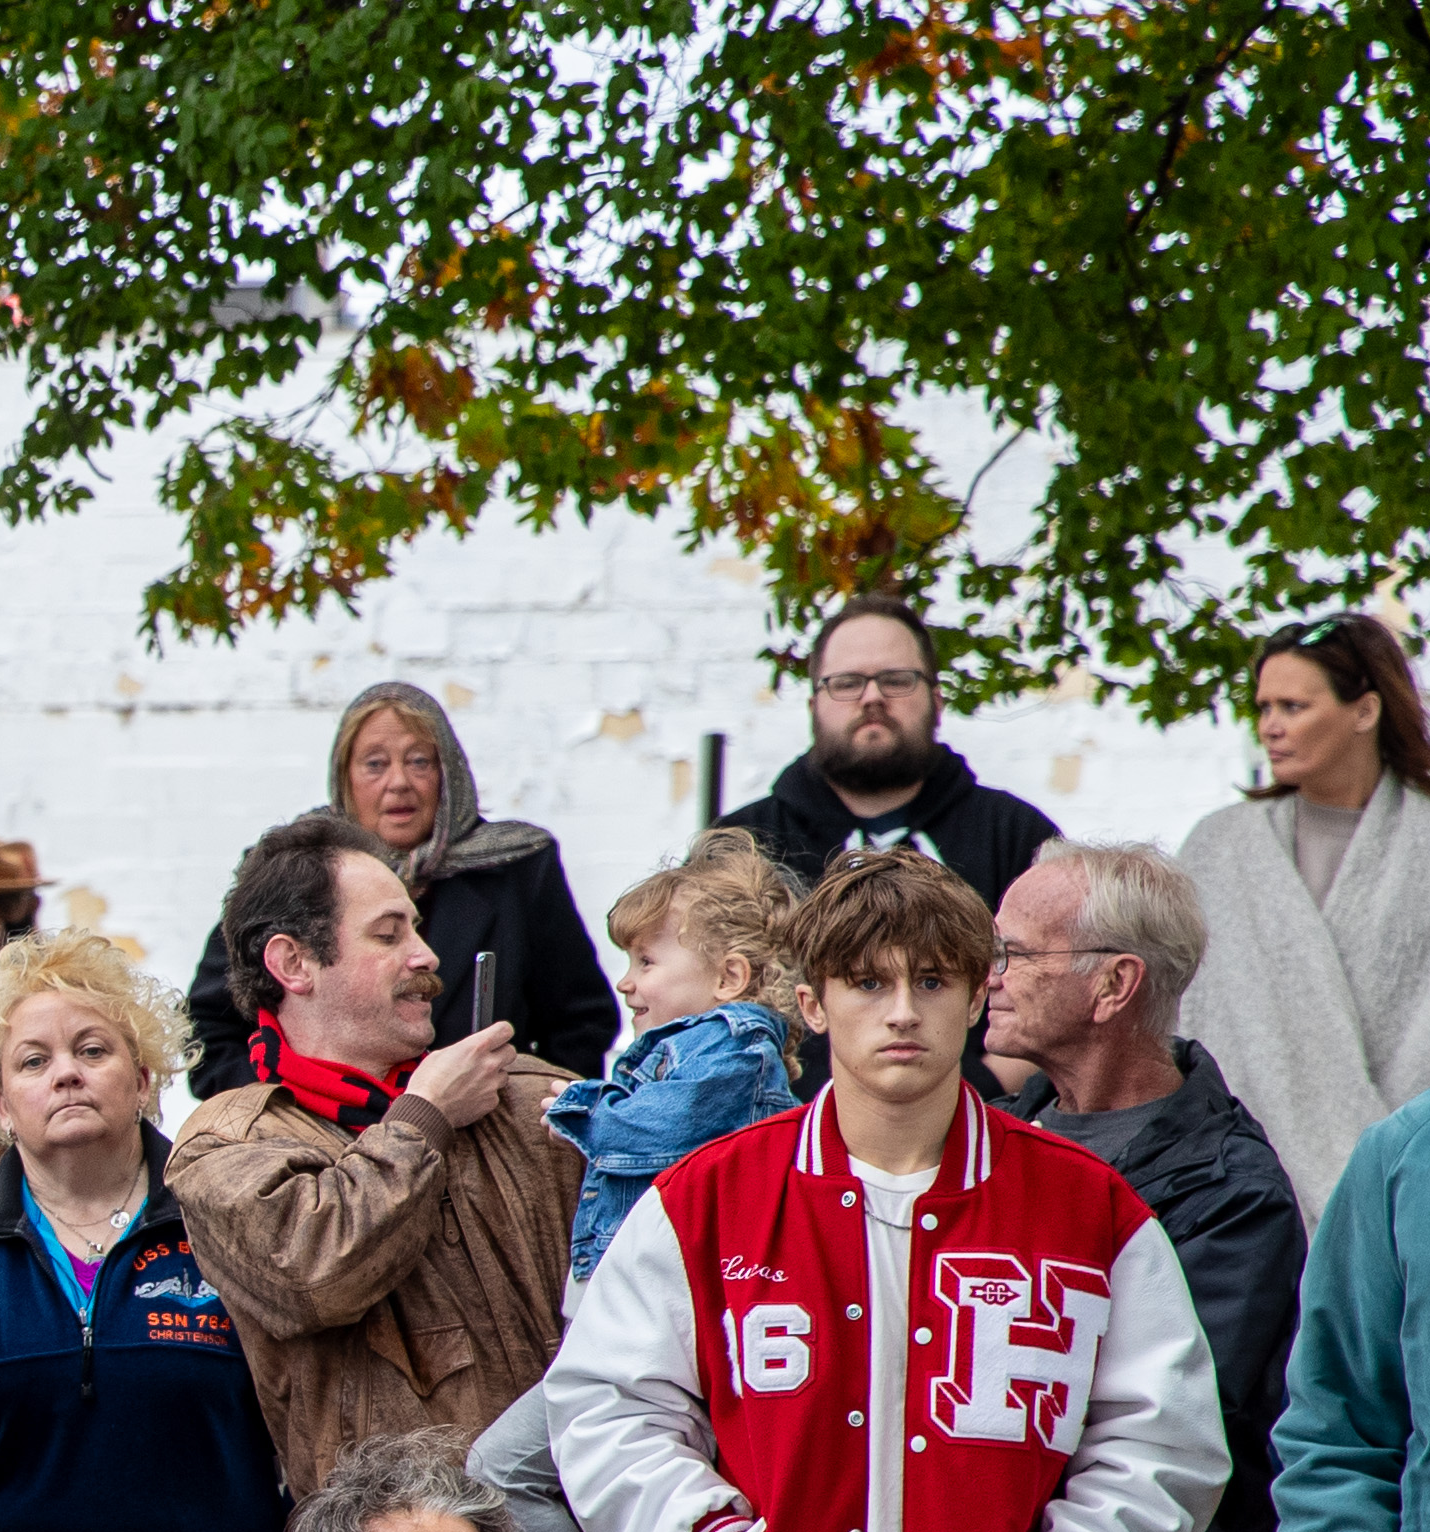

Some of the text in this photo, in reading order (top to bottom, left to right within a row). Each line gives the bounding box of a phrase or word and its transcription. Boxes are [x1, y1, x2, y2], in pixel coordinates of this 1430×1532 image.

[133, 1243, 170, 1271] USS
[721, 1255, 789, 1282] Lucas
[148, 1312, 230, 1331] SSN 764
